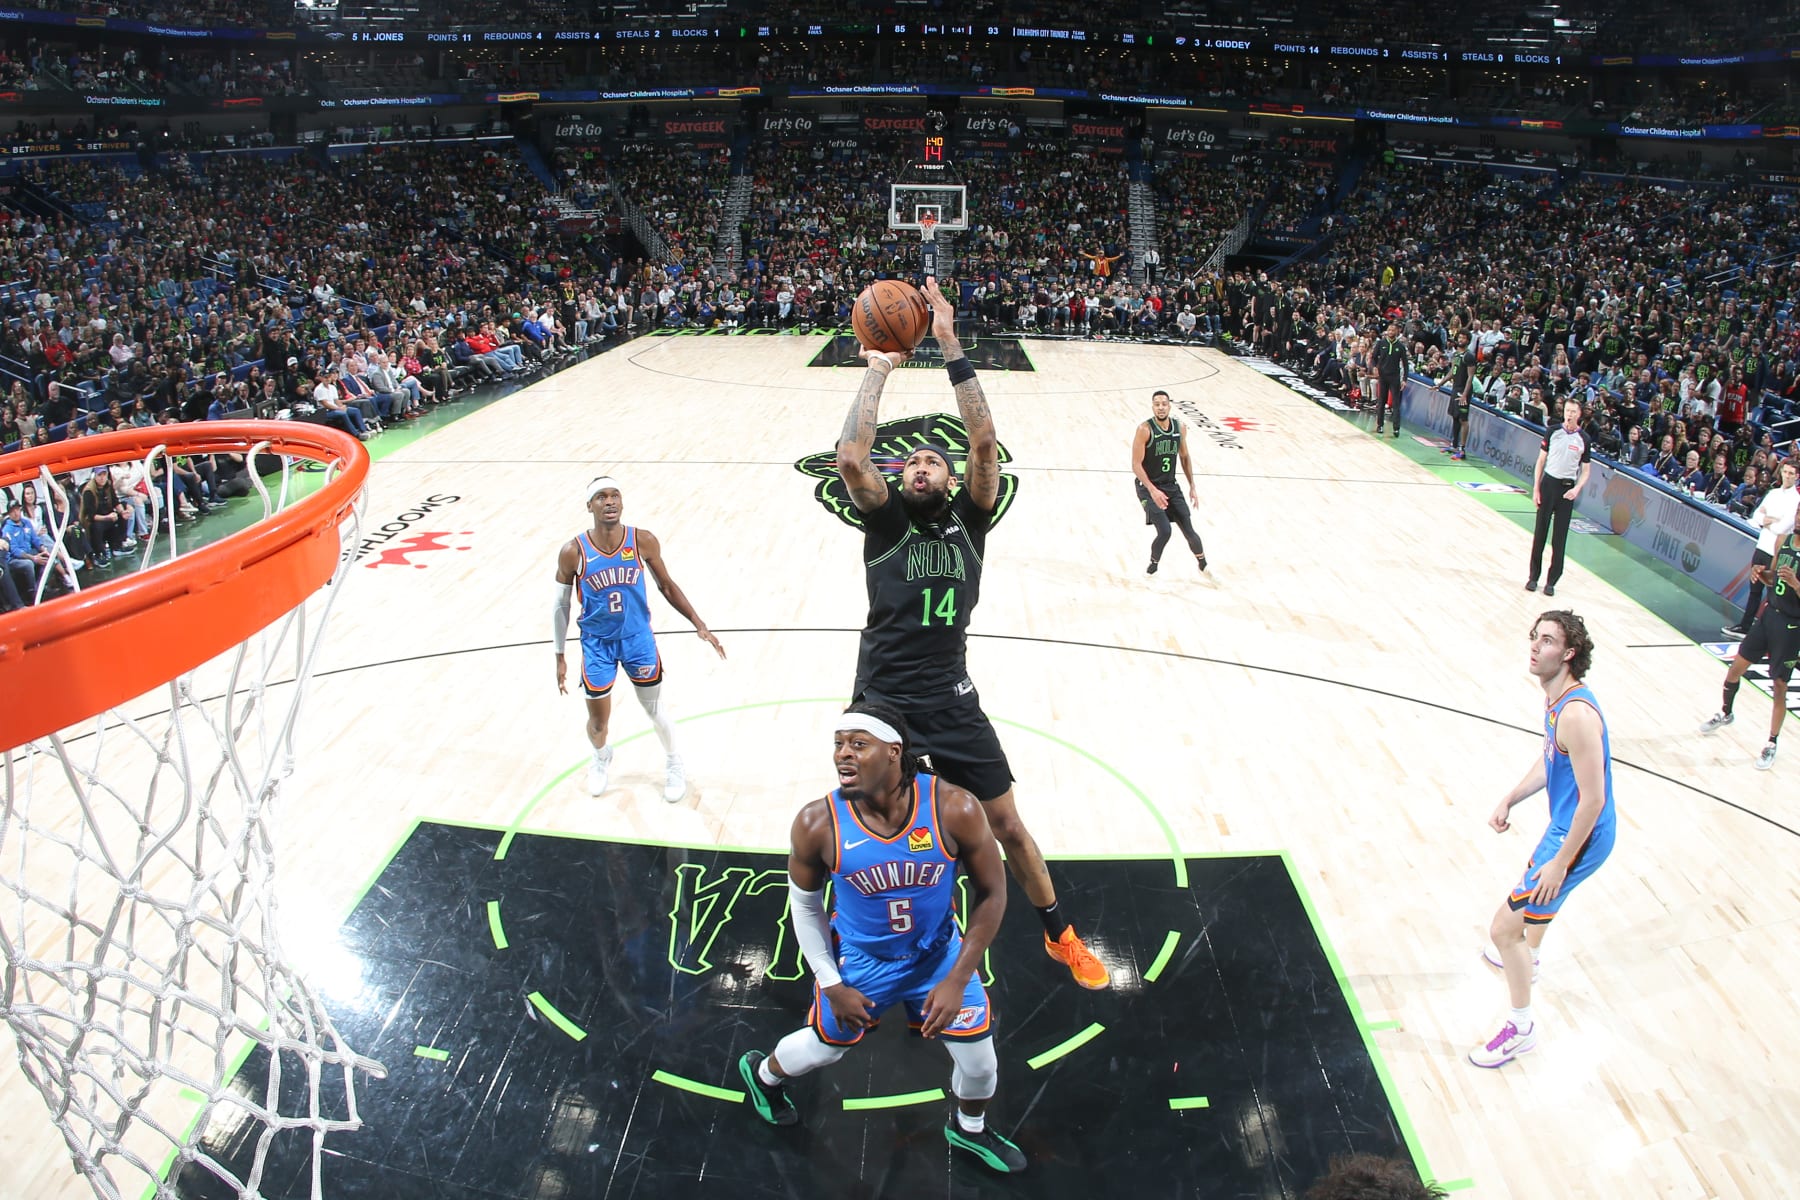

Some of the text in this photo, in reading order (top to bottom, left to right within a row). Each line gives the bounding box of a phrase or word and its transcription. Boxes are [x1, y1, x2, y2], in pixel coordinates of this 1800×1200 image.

[554, 32, 600, 40] ASSISTS 4
[616, 30, 660, 39] STEALS 2
[672, 29, 720, 38] BLOCKS 1
[894, 26, 906, 34] 85
[987, 27, 999, 35] 93
[352, 32, 404, 42] 5 H. JONES
[428, 34, 472, 42] POINTS 11
[484, 32, 542, 41] REBOUNDS 4
[1194, 38, 1251, 50] 3 J. GIDDEY
[1274, 44, 1320, 54] POINTS 14
[1330, 46, 1388, 58] REBOUNDS 3
[1402, 50, 1448, 60] ASSISTS 1
[1462, 53, 1504, 62] STEALS 0
[1514, 54, 1562, 65] BLOCKS 1
[630, 90, 660, 98] Children's
[662, 90, 688, 98] Hospital
[886, 86, 912, 94] Hospital
[86, 96, 160, 107] Ochsner Children's Hospital
[344, 96, 426, 106] Ochsner Children's Hospital
[1128, 96, 1159, 104] Children's
[1160, 98, 1186, 106] Hospital
[1370, 111, 1453, 124] Ochsner Children's Hospital
[556, 123, 602, 136] Let's Go
[665, 120, 726, 134] SEATGEEK
[764, 118, 812, 130] Let's Go
[864, 118, 926, 130] SEATGEEK
[966, 118, 995, 130] Let's
[1072, 124, 1124, 138] SEATGEEK
[1166, 128, 1215, 144] Let's Go
[1624, 127, 1649, 135] Ochsner
[1680, 129, 1702, 138] Hospital
[87, 142, 130, 150] BETRIVERS
[926, 136, 944, 146] 1:40
[12, 144, 61, 154] BETRIVERS
[924, 146, 942, 162] 14
[862, 296, 888, 345] Wilson
[1155, 440, 1178, 457] NOLA
[1484, 440, 1513, 467] Google
[1162, 457, 1170, 473] 3
[1657, 496, 1712, 546] TOMORROW
[906, 540, 966, 582] NOLA
[586, 566, 640, 592] THUNDER
[1776, 578, 1786, 596] 5
[608, 590, 624, 614] 2
[921, 587, 957, 627] 14
[844, 862, 947, 897] THUNDER
[887, 898, 914, 934] 5
